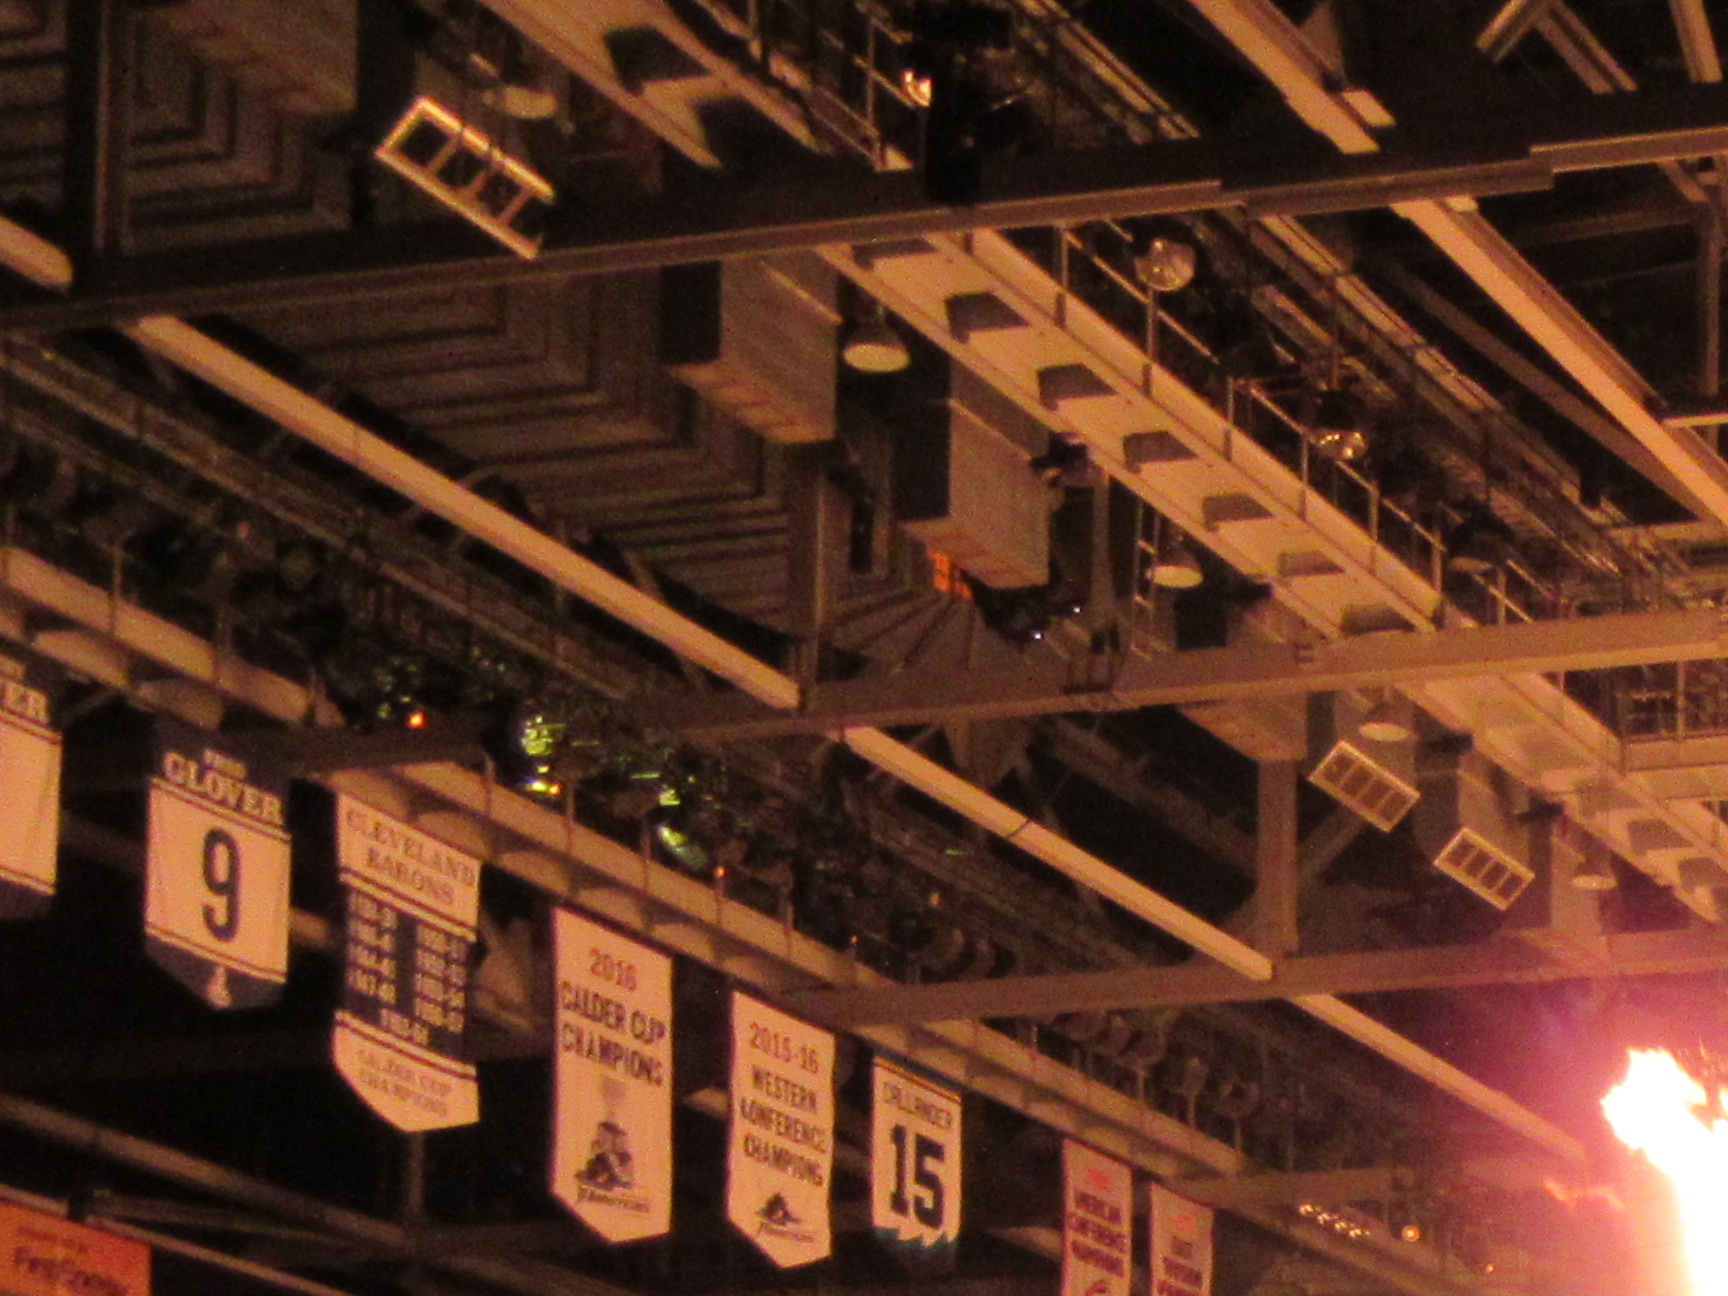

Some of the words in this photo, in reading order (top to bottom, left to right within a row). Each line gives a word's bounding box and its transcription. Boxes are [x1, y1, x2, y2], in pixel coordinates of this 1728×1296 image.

[163, 751, 284, 827] GLOVER
[346, 807, 476, 888] CLEVELAND
[202, 828, 241, 940] 9
[590, 948, 637, 992] 2016
[629, 1008, 667, 1045] CUP
[750, 1021, 819, 1074] 2015-16
[752, 1065, 818, 1113] WESTERN
[890, 1124, 945, 1230] 15
